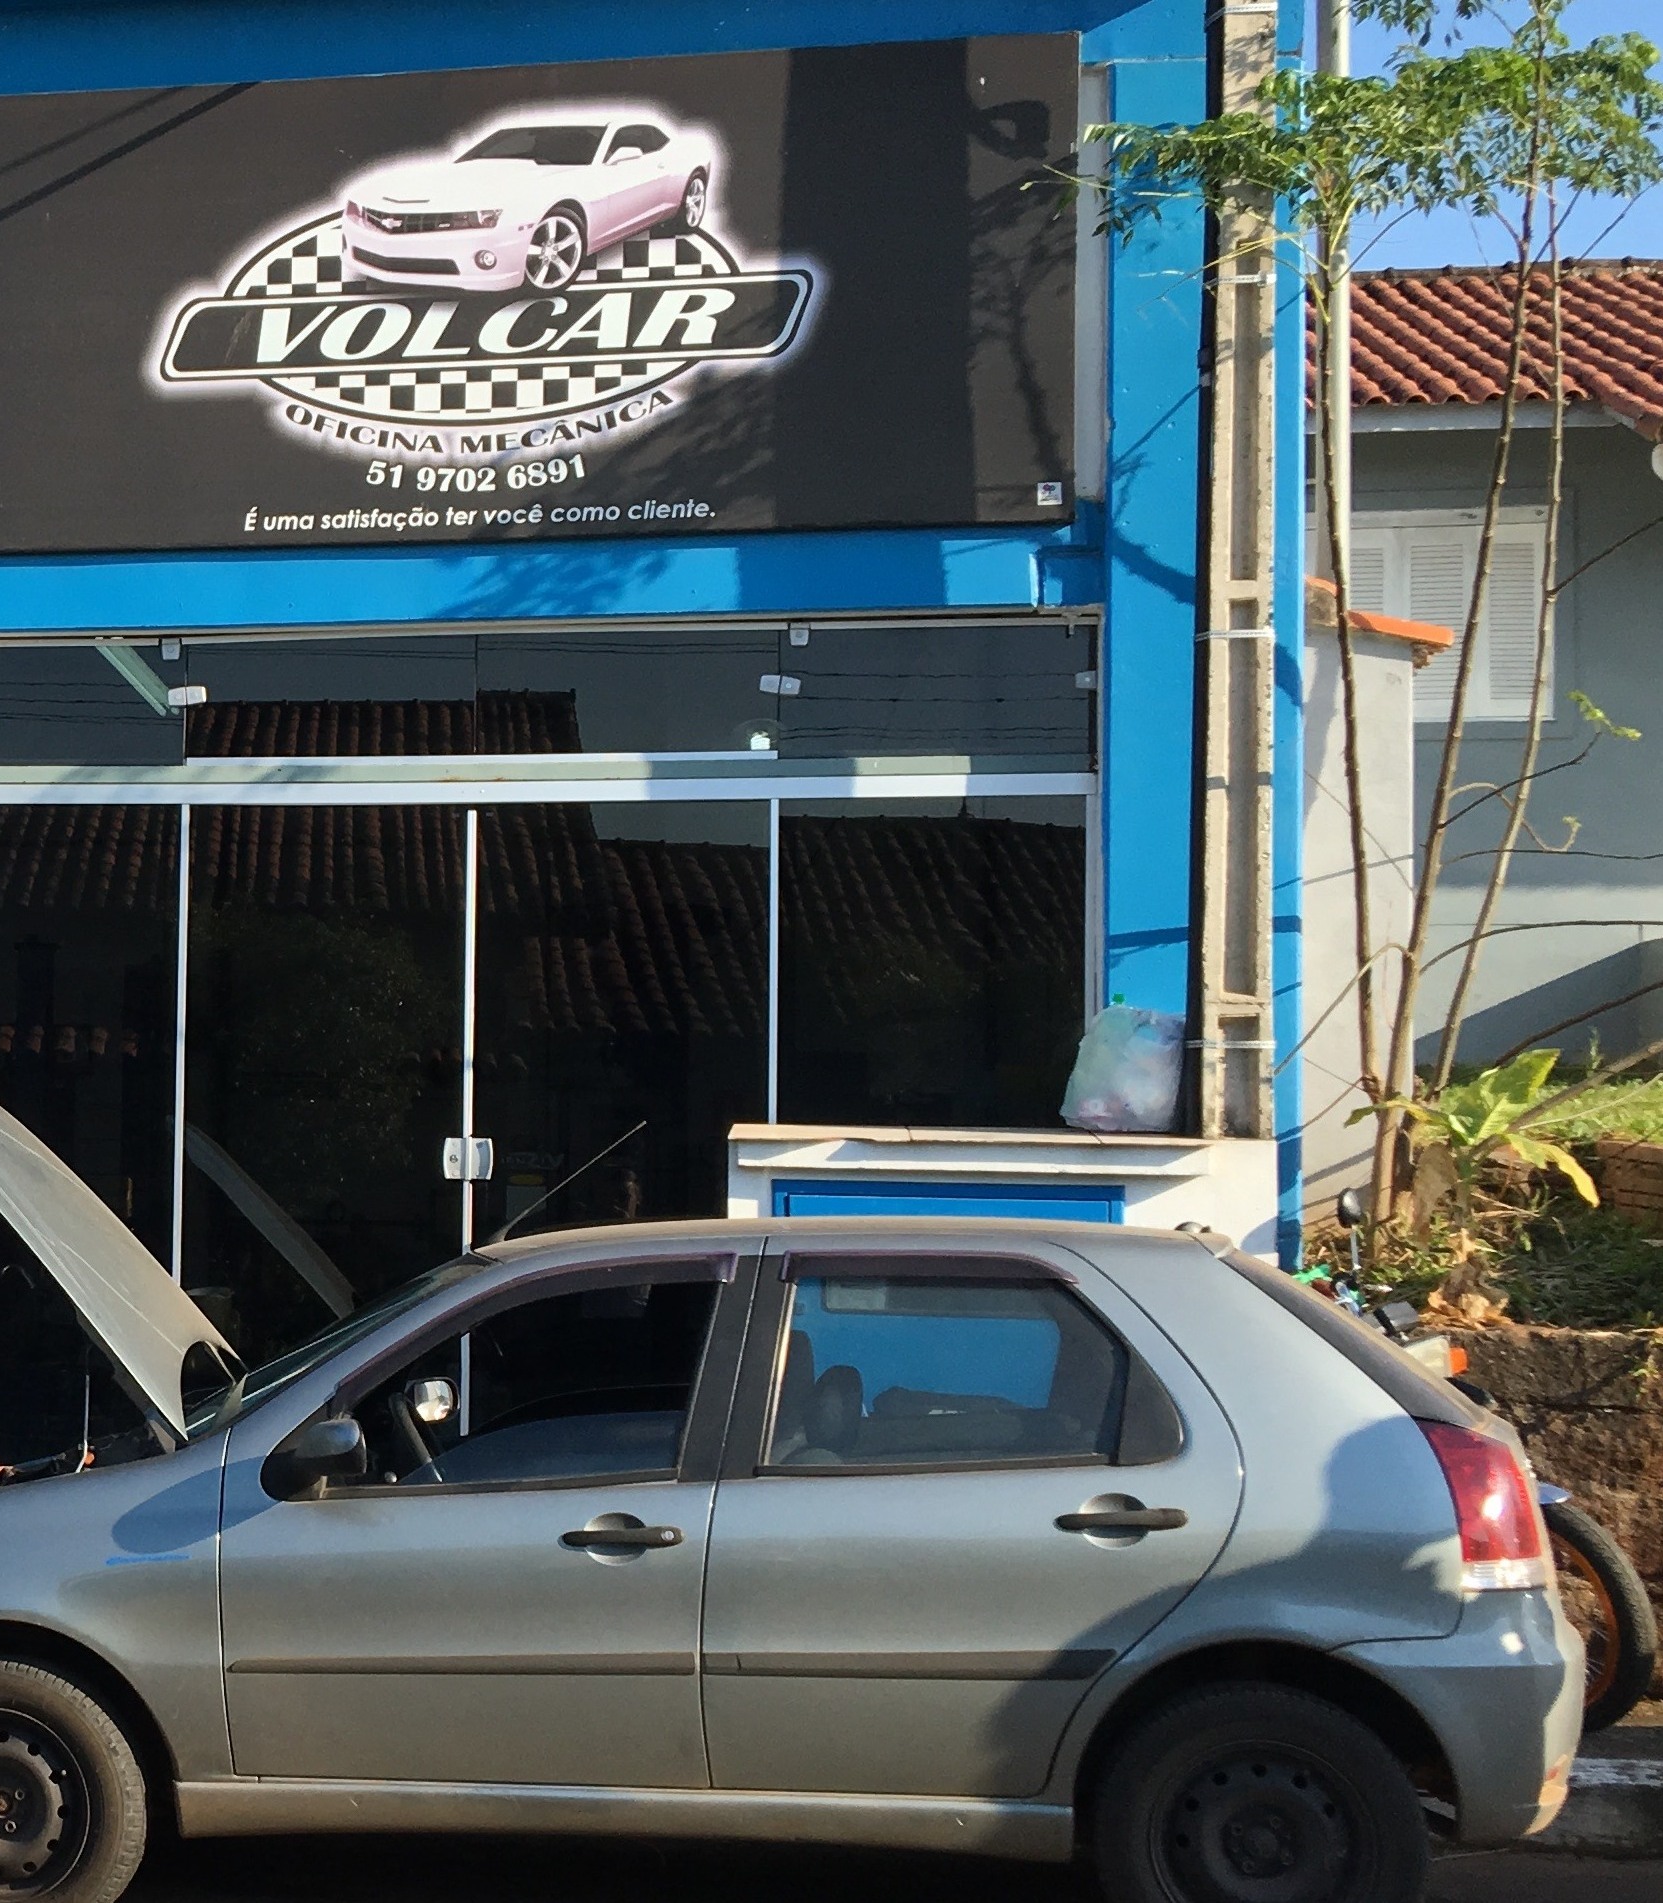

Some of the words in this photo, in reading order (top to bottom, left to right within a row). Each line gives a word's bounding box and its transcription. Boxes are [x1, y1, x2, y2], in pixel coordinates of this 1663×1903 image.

[255, 288, 737, 364] VOLCAR
[285, 403, 444, 454] OFICINA
[460, 388, 676, 454] MECÂNICA
[365, 461, 405, 489] 51
[416, 467, 497, 493] 9702
[506, 454, 587, 490] 6891
[244, 505, 260, 532] É
[263, 512, 314, 532] uma
[320, 505, 439, 533] satisfação
[445, 507, 478, 527] ter
[483, 502, 544, 526] você
[550, 505, 622, 524] como
[627, 497, 717, 522] cliente.
